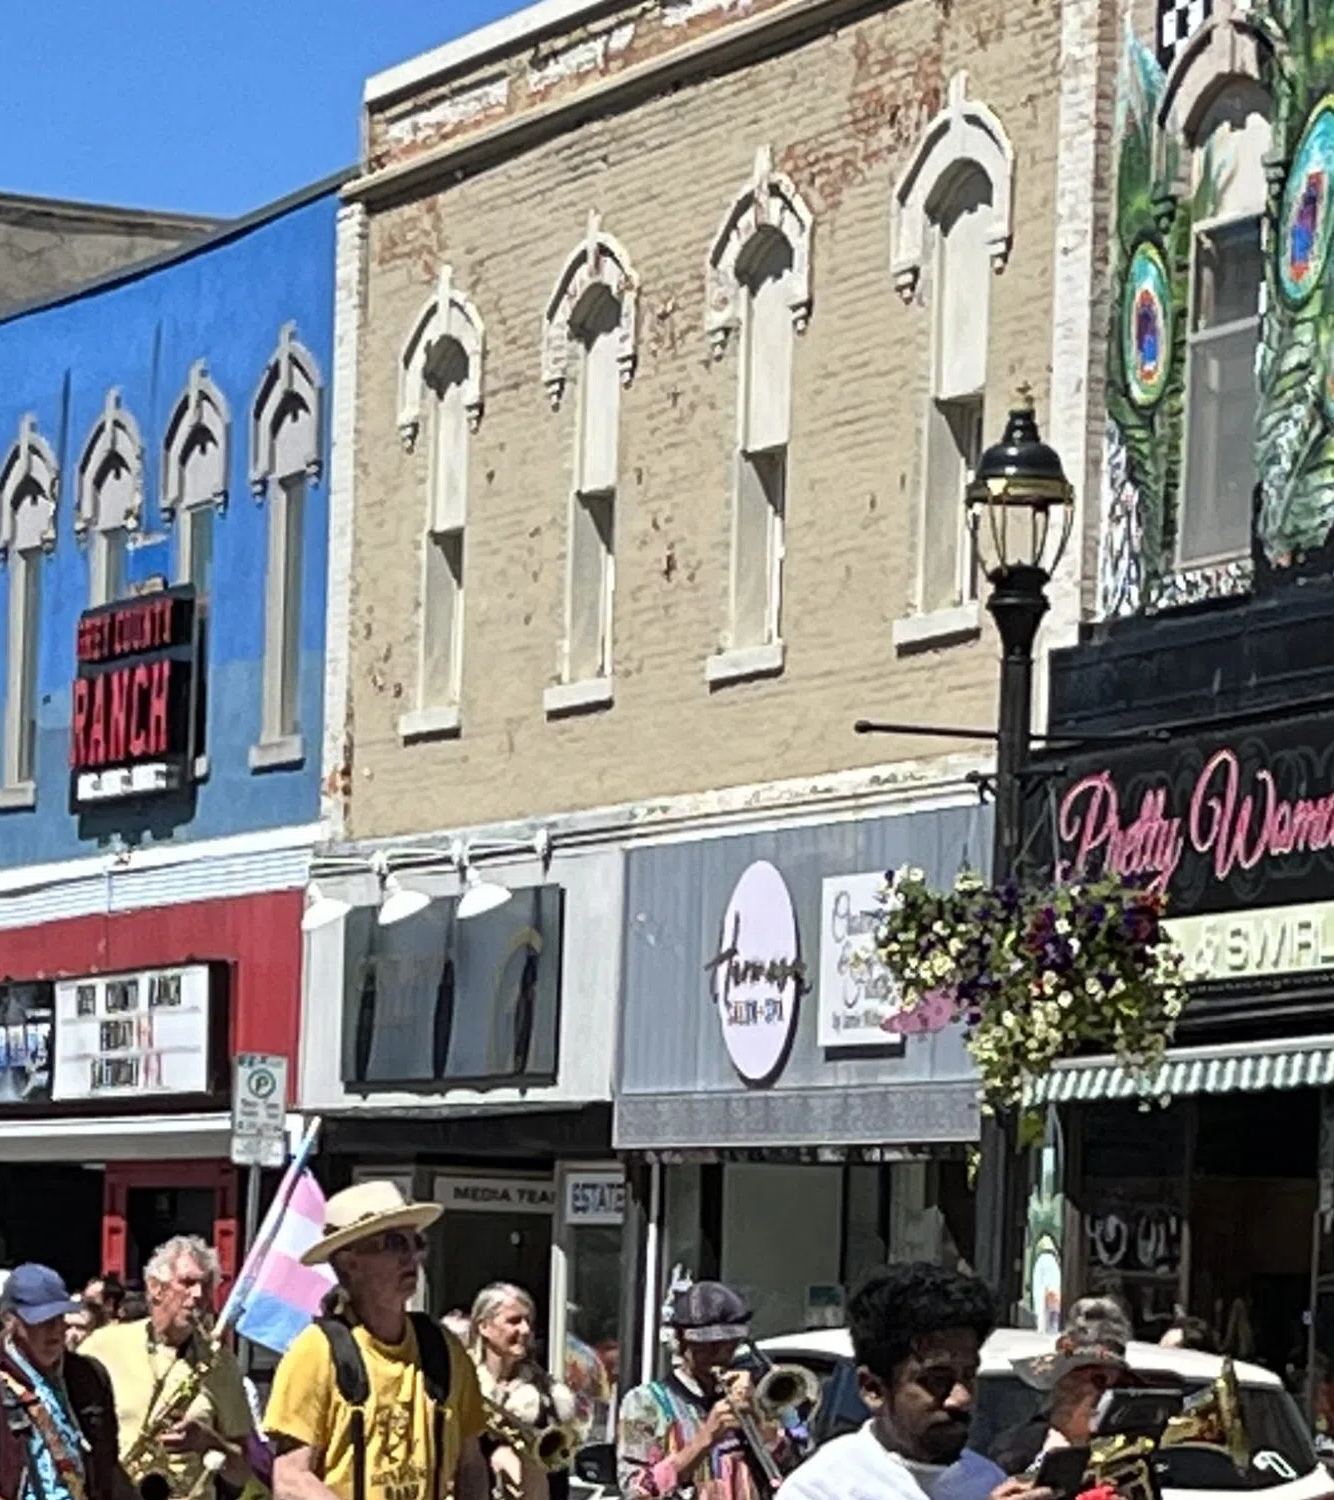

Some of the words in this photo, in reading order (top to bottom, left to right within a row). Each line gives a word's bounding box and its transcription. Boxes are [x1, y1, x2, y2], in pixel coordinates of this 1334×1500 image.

[70, 658, 171, 771] RANCH
[1060, 770, 1184, 894] Pretty
[453, 1186, 512, 1202] MEDIA
